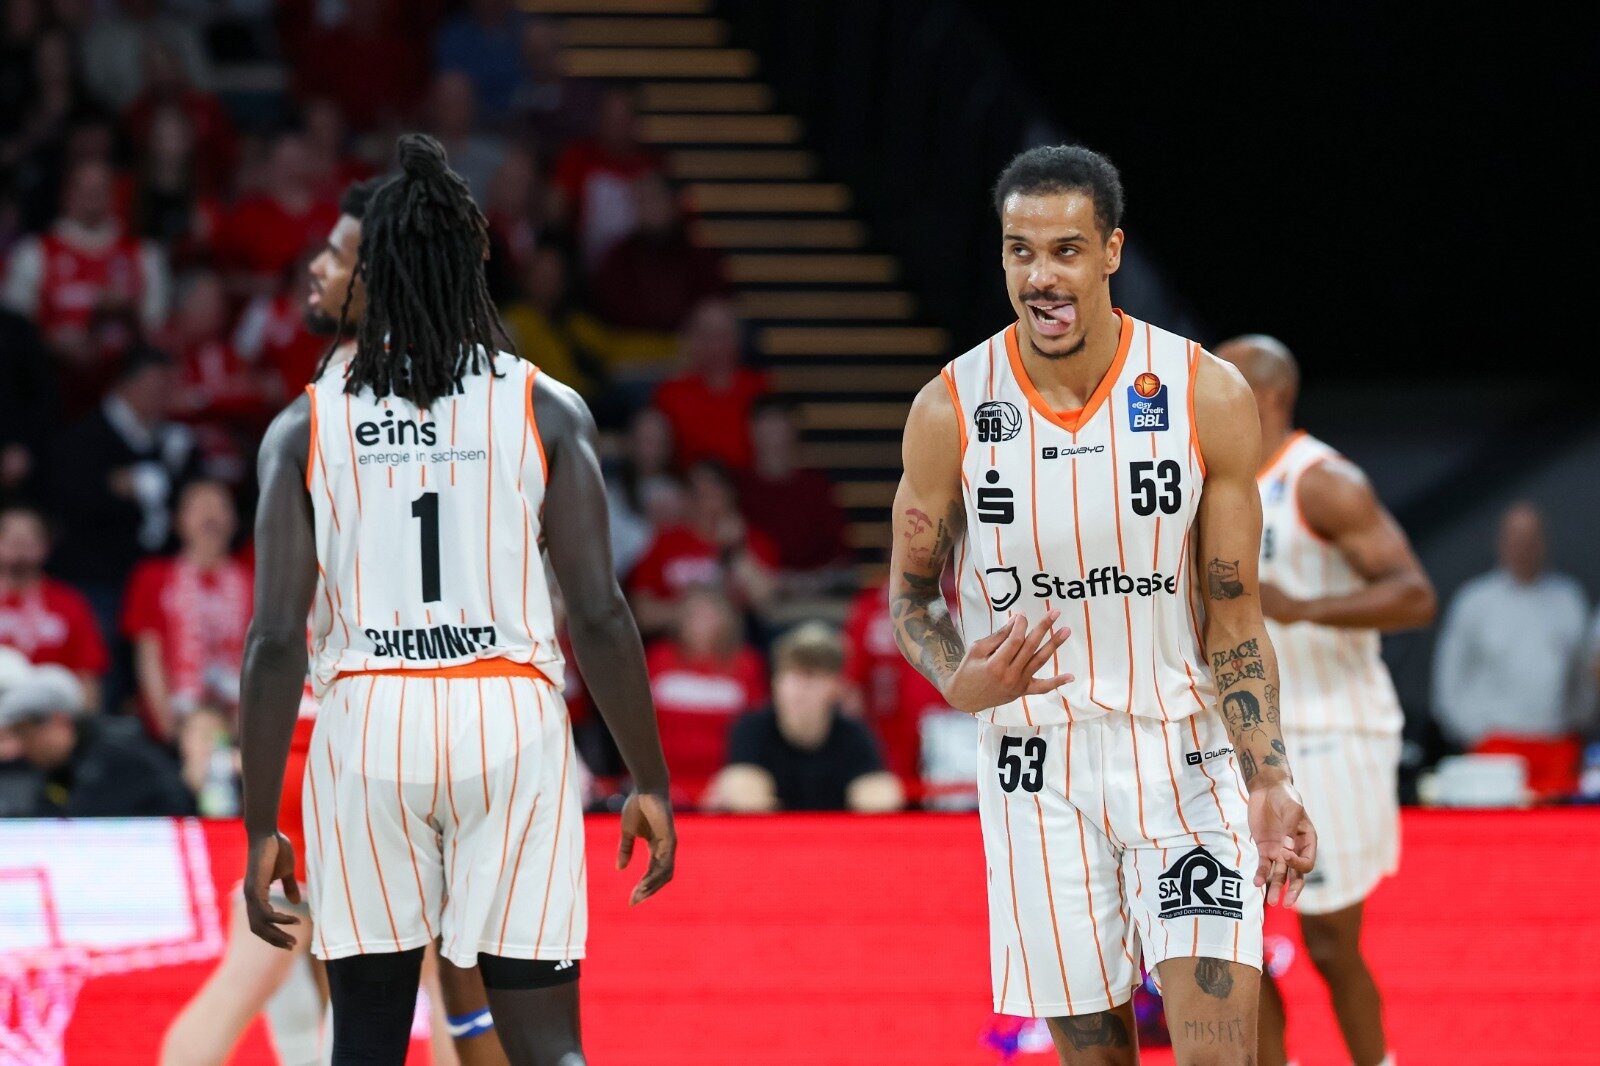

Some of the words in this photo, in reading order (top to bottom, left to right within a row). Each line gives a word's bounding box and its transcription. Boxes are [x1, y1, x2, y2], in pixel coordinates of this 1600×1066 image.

[1133, 414, 1165, 428] BBL
[1141, 406, 1164, 414] Credit
[355, 410, 437, 446] eins
[978, 417, 1002, 442] 99
[358, 451, 410, 467] energie
[416, 450, 426, 461] in
[431, 448, 487, 463] sachsen
[1129, 459, 1182, 516] 53
[411, 492, 442, 603] 1
[1031, 566, 1176, 600] Staffbase
[364, 624, 497, 661] CHEMNITZ
[998, 735, 1047, 793] 53
[1204, 747, 1236, 760] oway
